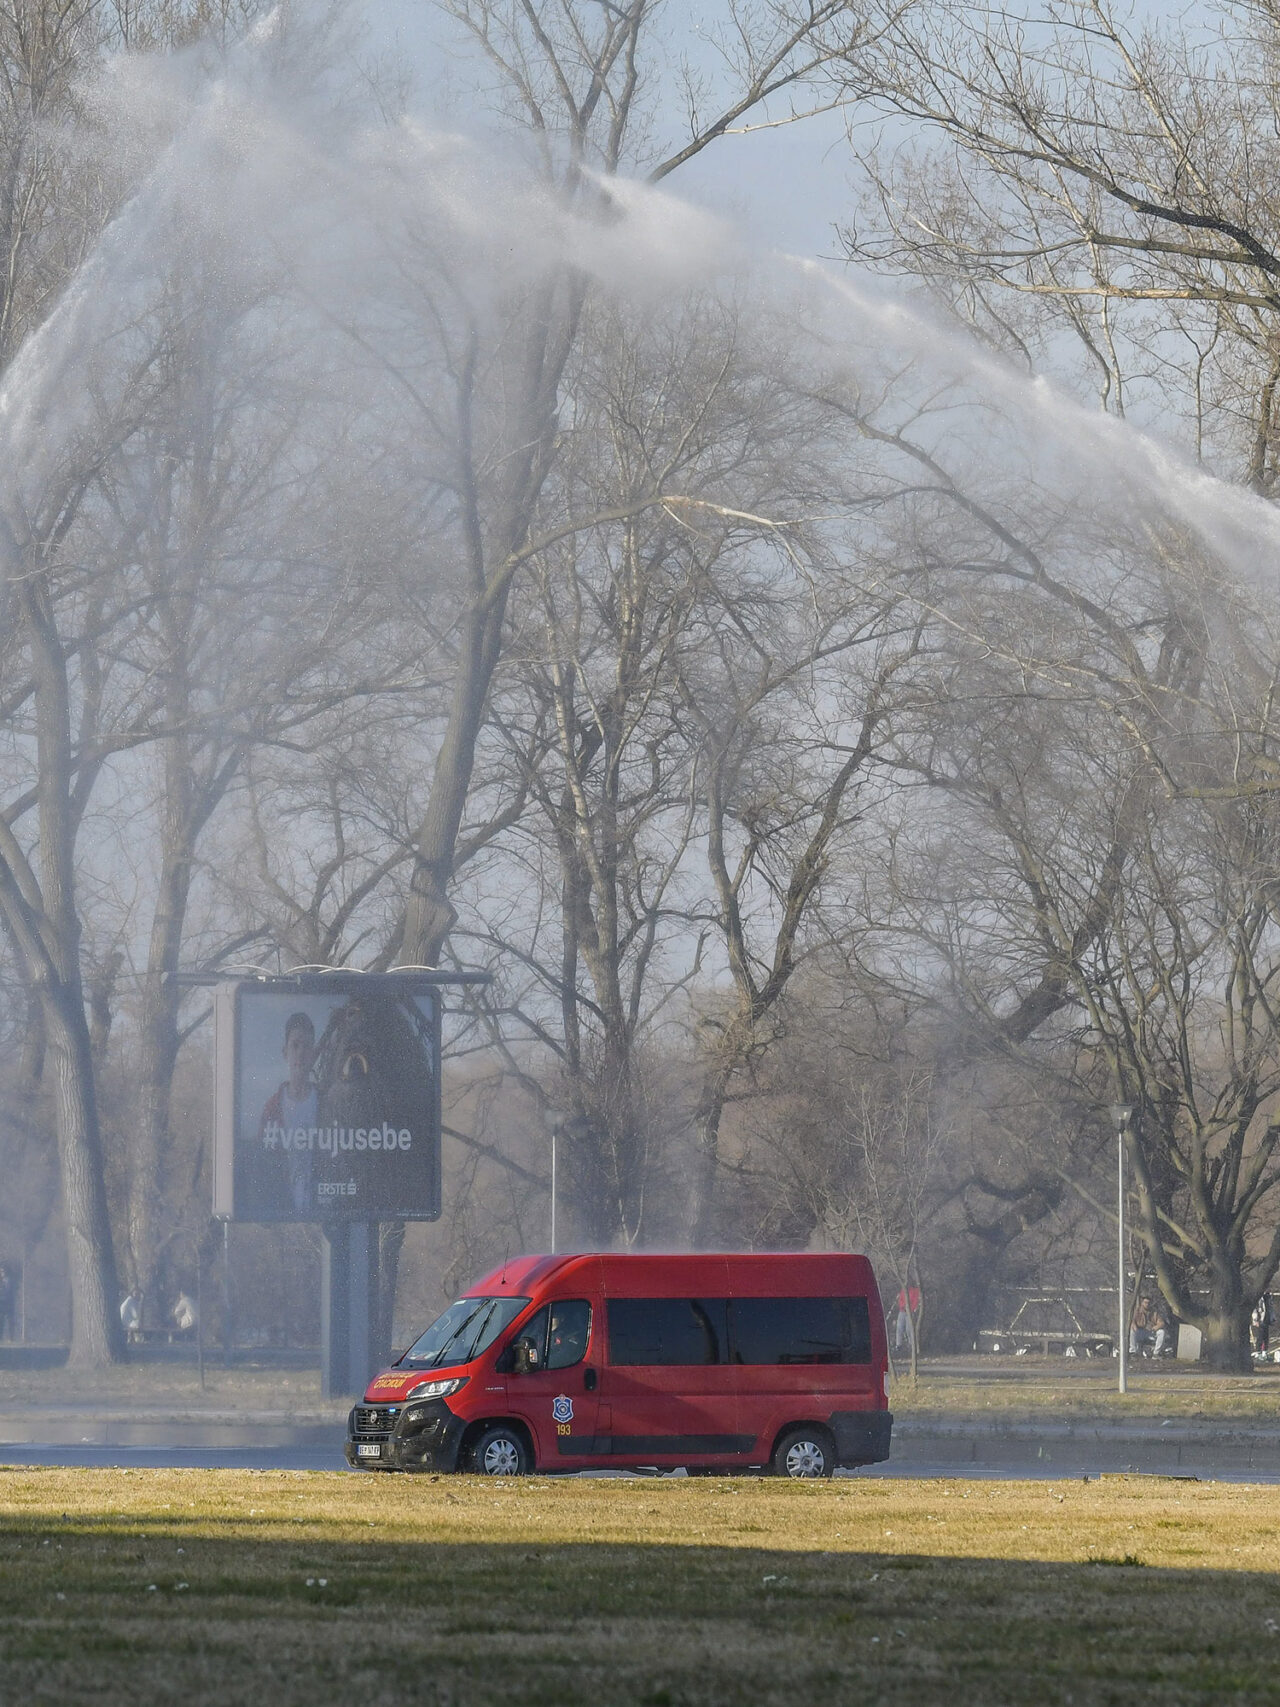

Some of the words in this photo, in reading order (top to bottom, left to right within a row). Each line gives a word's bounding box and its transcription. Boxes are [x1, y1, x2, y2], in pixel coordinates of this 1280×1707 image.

[263, 1120, 412, 1158] #verujusebe
[318, 1183, 346, 1195] ERSTE
[556, 1424, 571, 1436] 193
